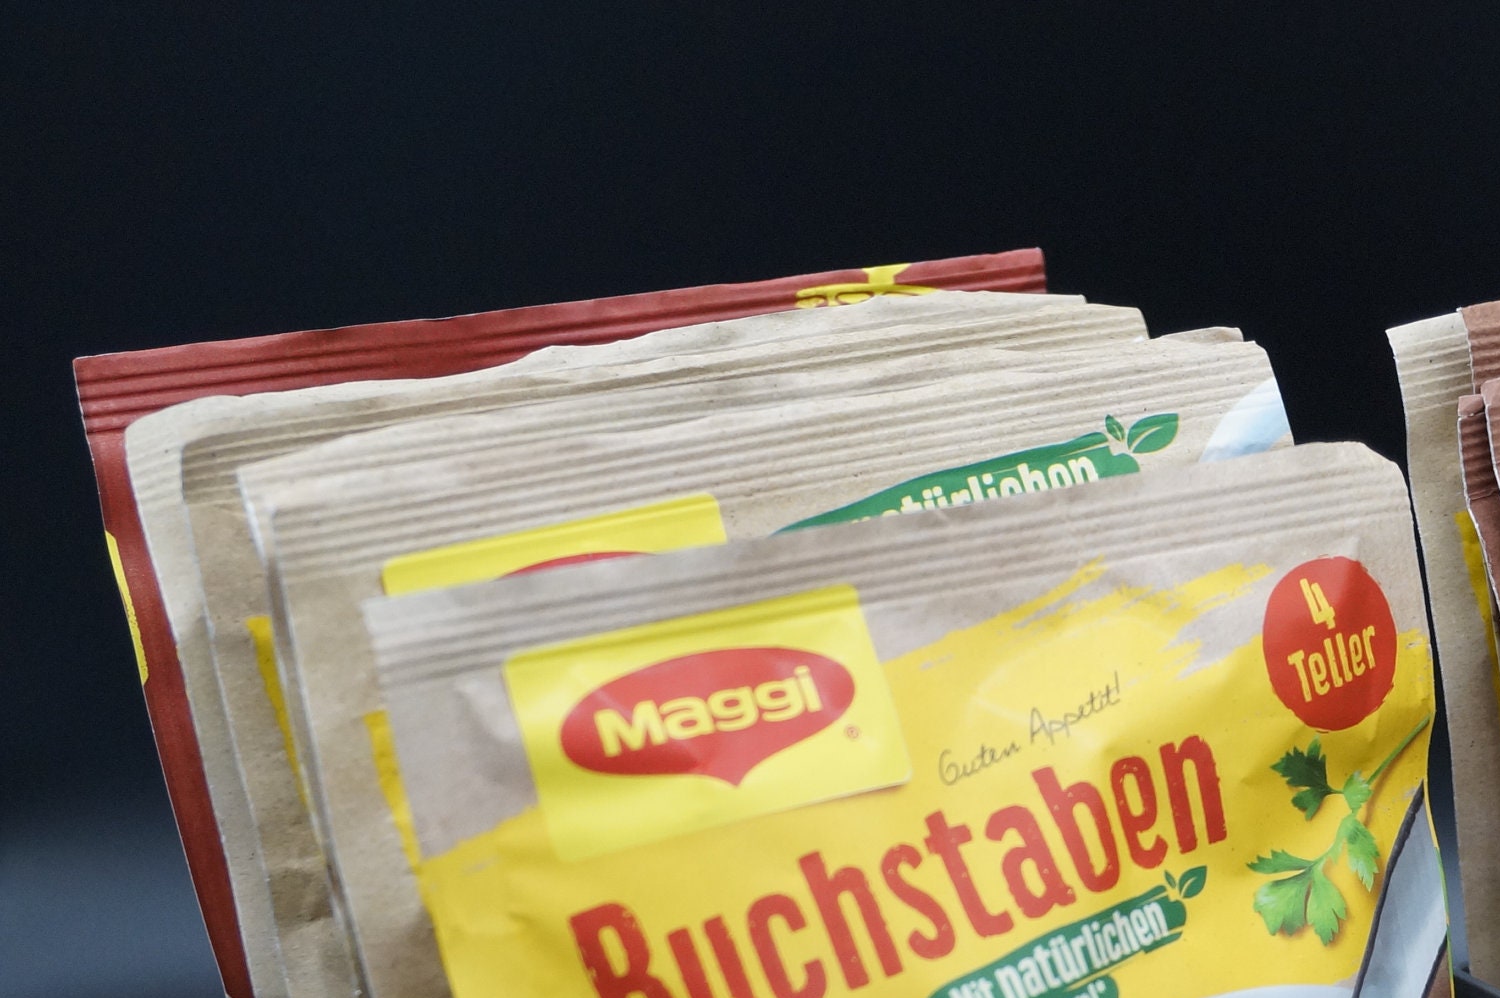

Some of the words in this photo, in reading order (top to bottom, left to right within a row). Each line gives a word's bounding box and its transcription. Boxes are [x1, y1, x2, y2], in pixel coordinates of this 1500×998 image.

[1300, 578, 1335, 629] 4
[1287, 624, 1377, 702] Teller
[593, 664, 823, 758] Maggi
[938, 740, 1022, 787] Guten
[1028, 670, 1122, 746] Appetit!
